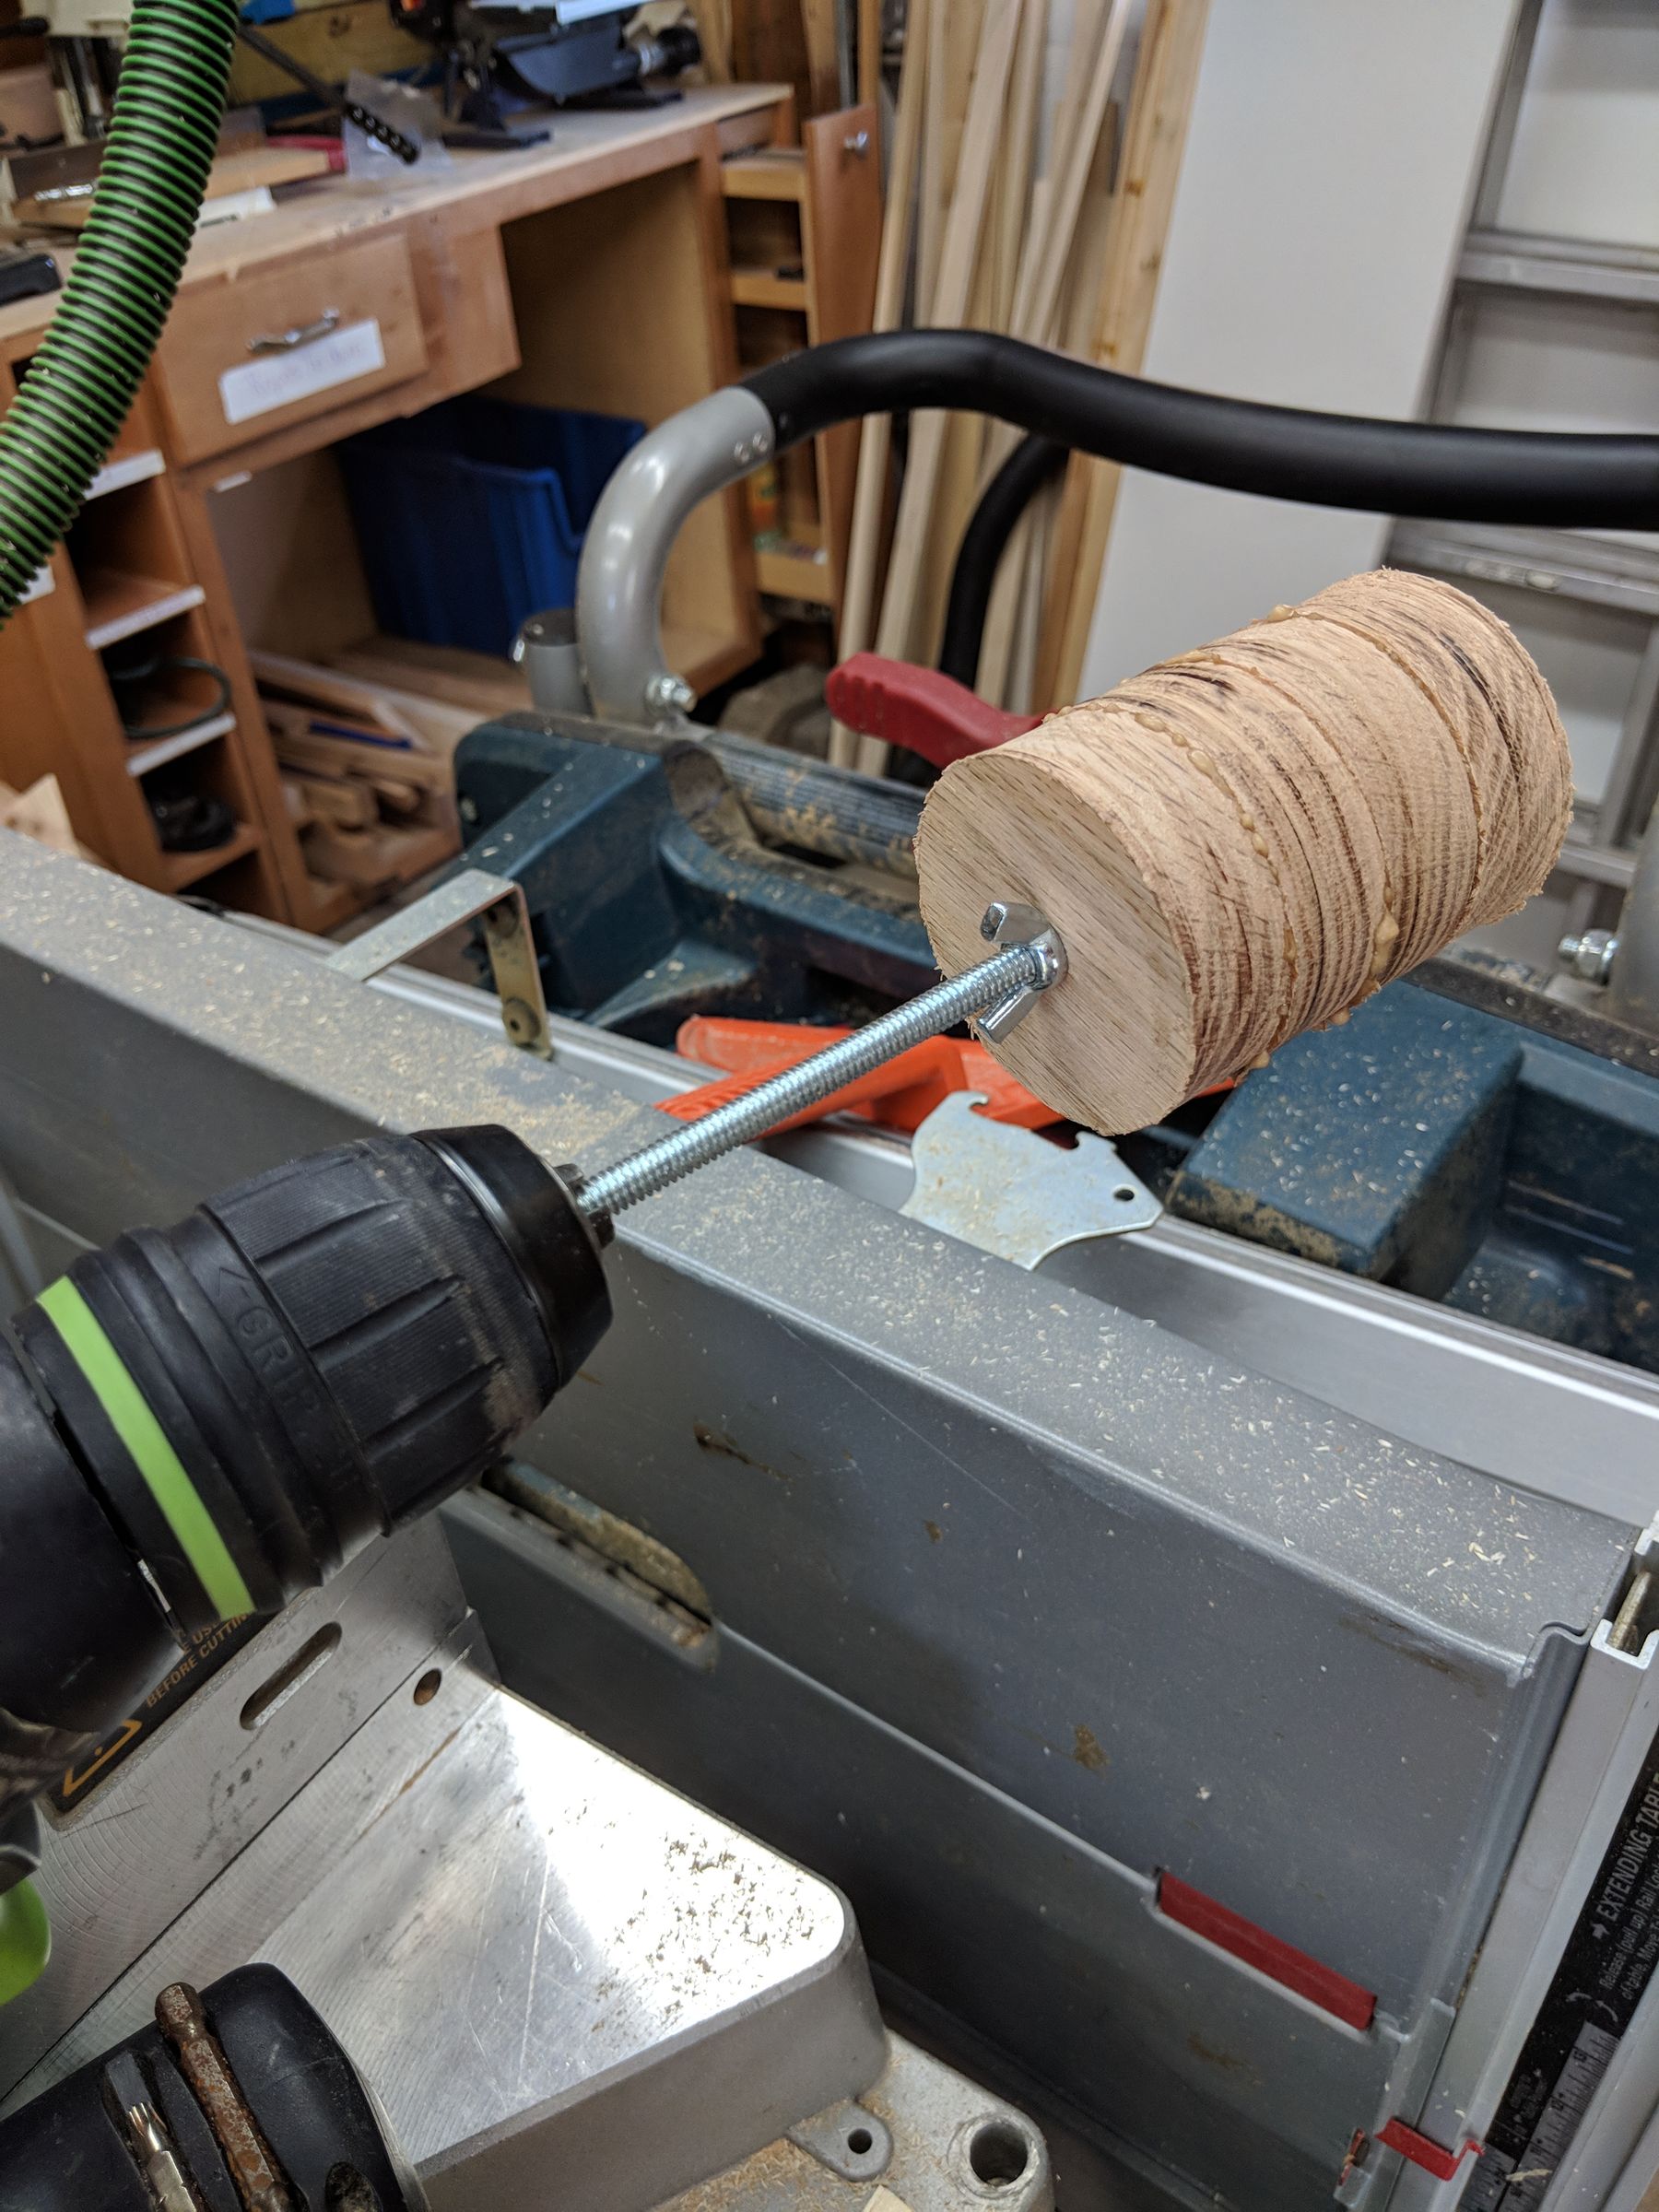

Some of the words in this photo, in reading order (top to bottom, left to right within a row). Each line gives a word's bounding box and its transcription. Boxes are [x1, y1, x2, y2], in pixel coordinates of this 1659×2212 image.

[147, 1654, 198, 1708] BEFORE
[1596, 1829, 1652, 1922] EXTENDING
[1635, 1772, 1659, 1829] TAB
